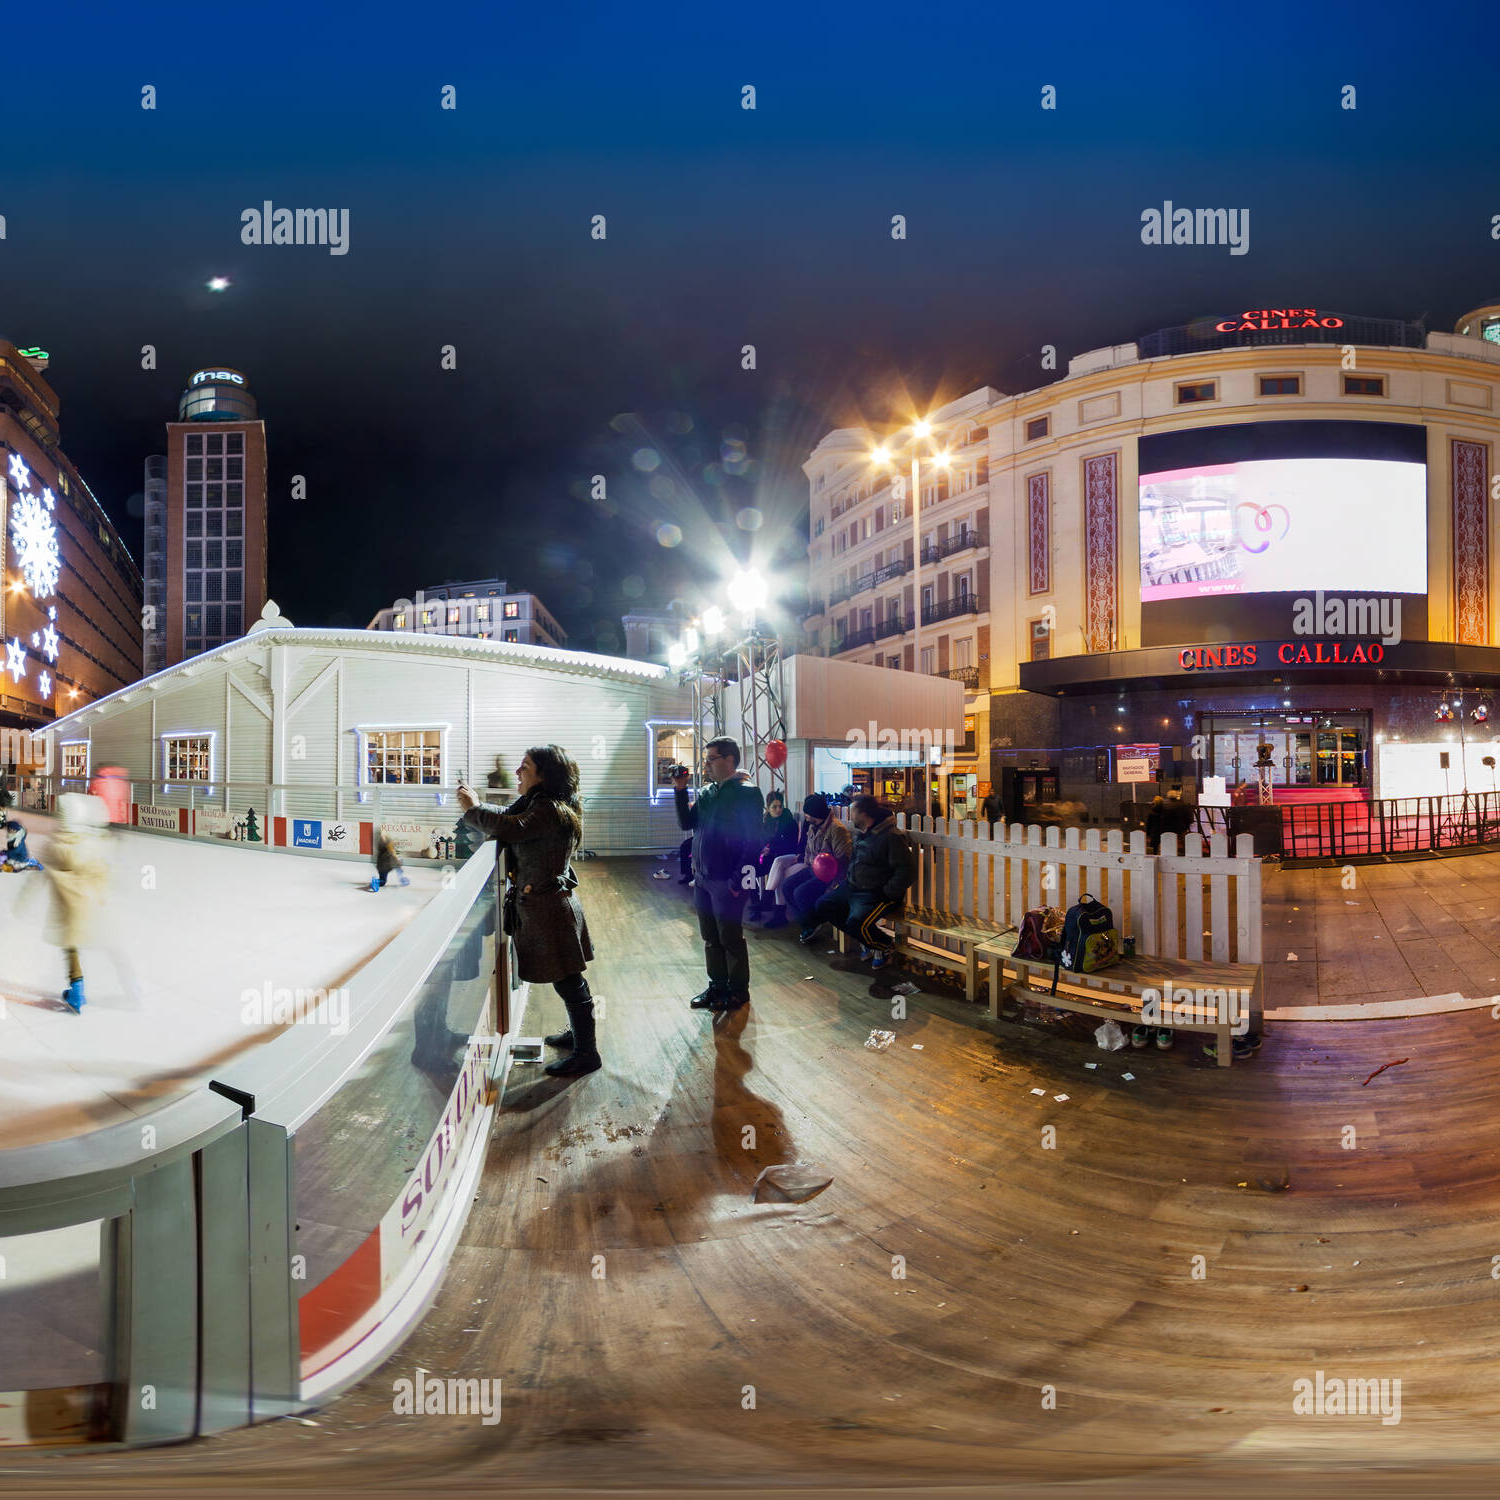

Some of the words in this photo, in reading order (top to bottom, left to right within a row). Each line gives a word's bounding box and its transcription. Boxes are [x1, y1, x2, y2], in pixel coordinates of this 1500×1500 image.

[1242, 309, 1317, 320] CINES
[1215, 318, 1344, 332] CALLAO
[193, 370, 244, 385] fnac
[1178, 645, 1257, 670] CINES
[1278, 643, 1385, 664] CALLAO
[140, 805, 157, 815] SOLO
[141, 816, 176, 830] NAVIDAD
